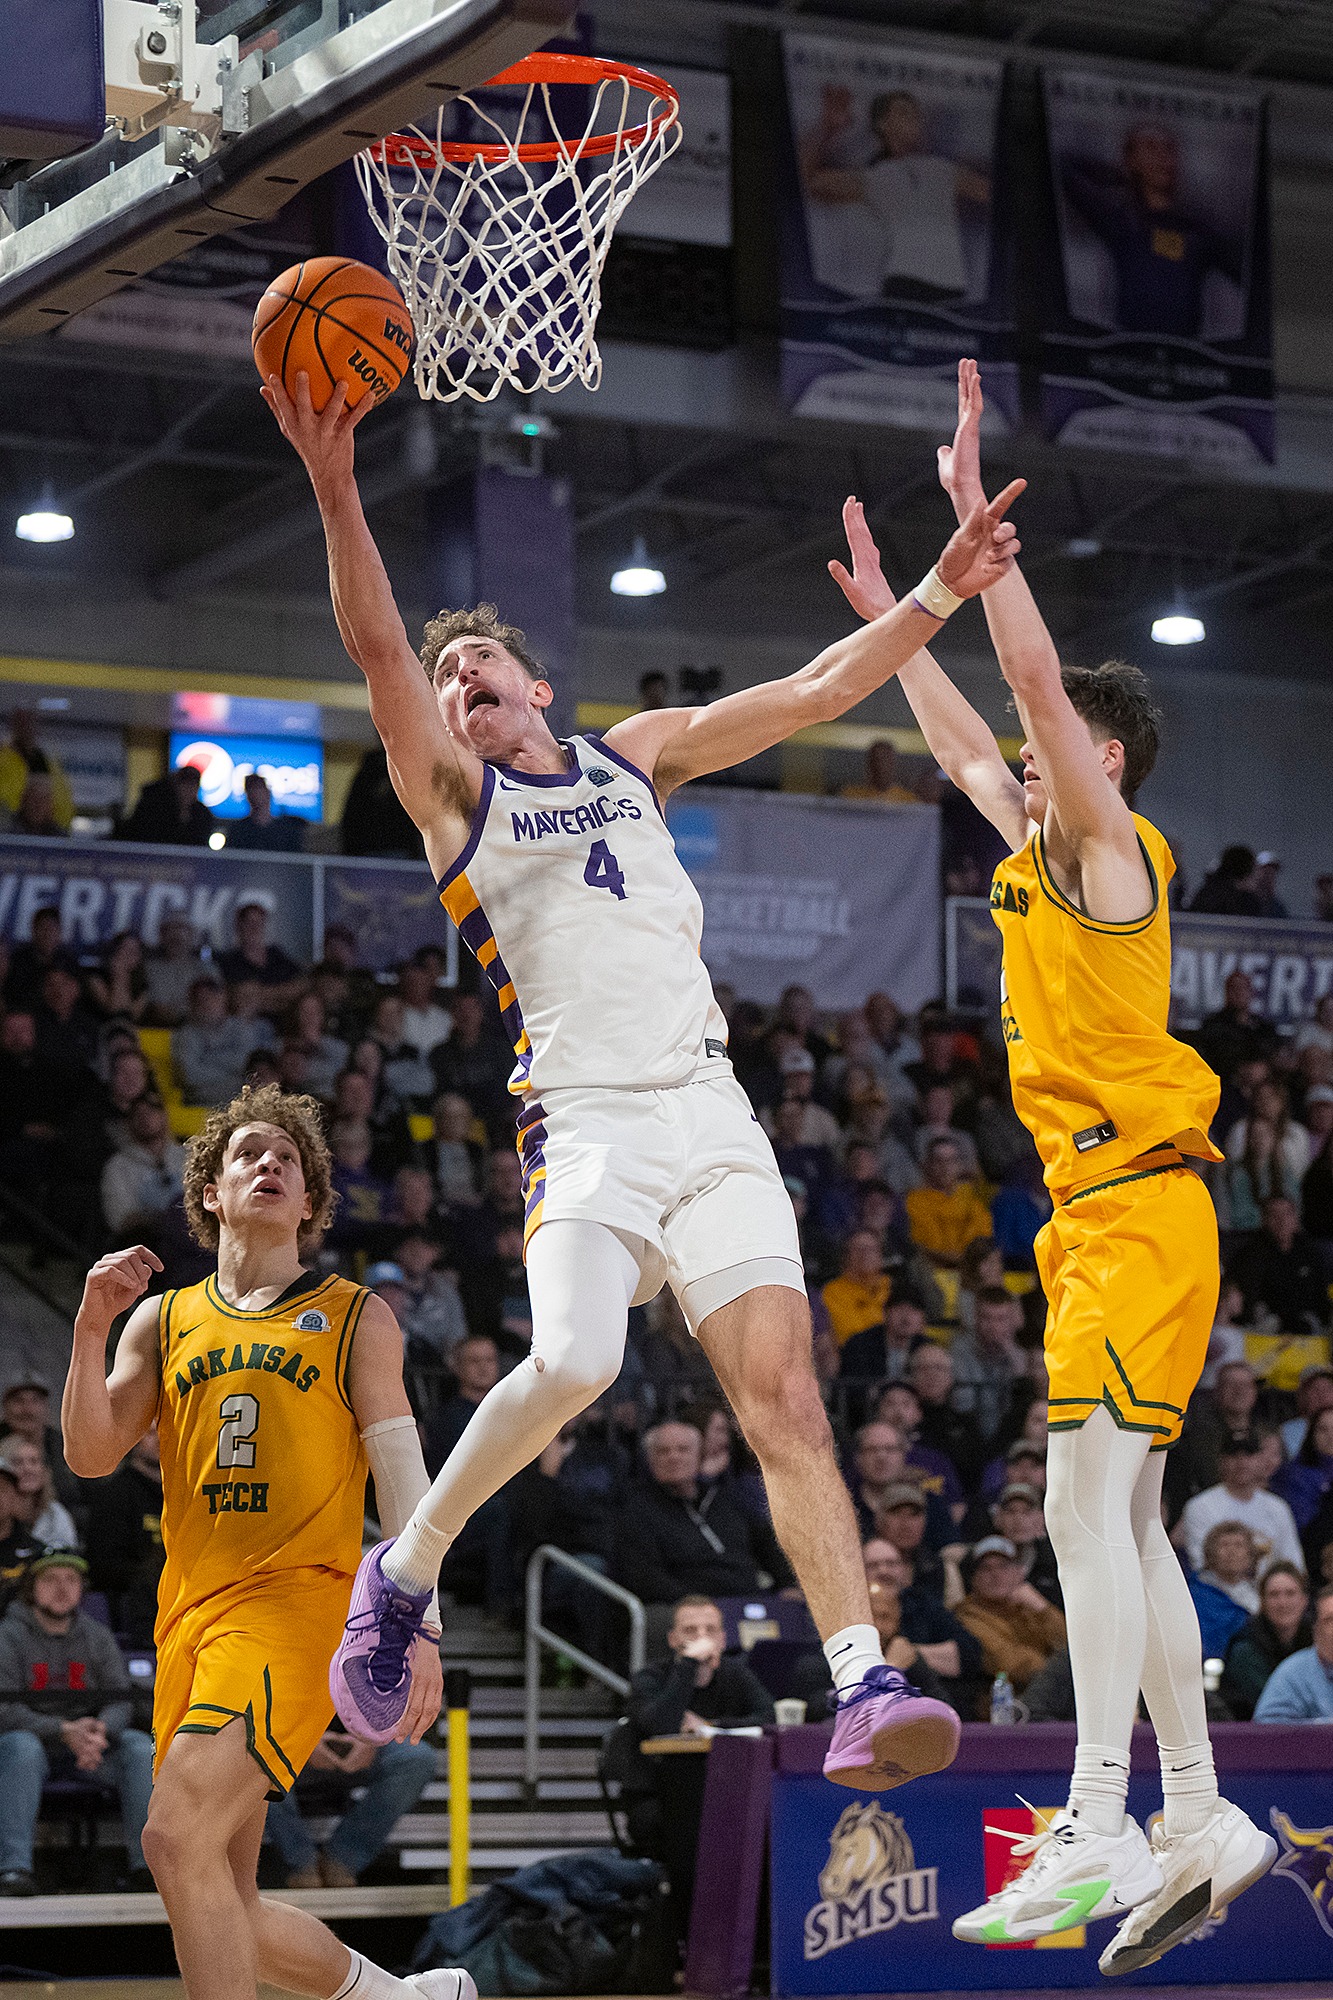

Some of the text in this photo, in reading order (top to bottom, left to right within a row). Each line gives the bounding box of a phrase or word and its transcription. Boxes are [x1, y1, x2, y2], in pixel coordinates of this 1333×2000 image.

[383, 317, 412, 358] CAA
[510, 794, 642, 842] MAVERICS
[583, 838, 629, 901] 4
[990, 880, 1030, 918] SAS
[175, 1342, 321, 1399] ARKANSAS
[216, 1392, 261, 1470] 2
[202, 1481, 270, 1515] TECH
[805, 1869, 938, 1959] SMSU
